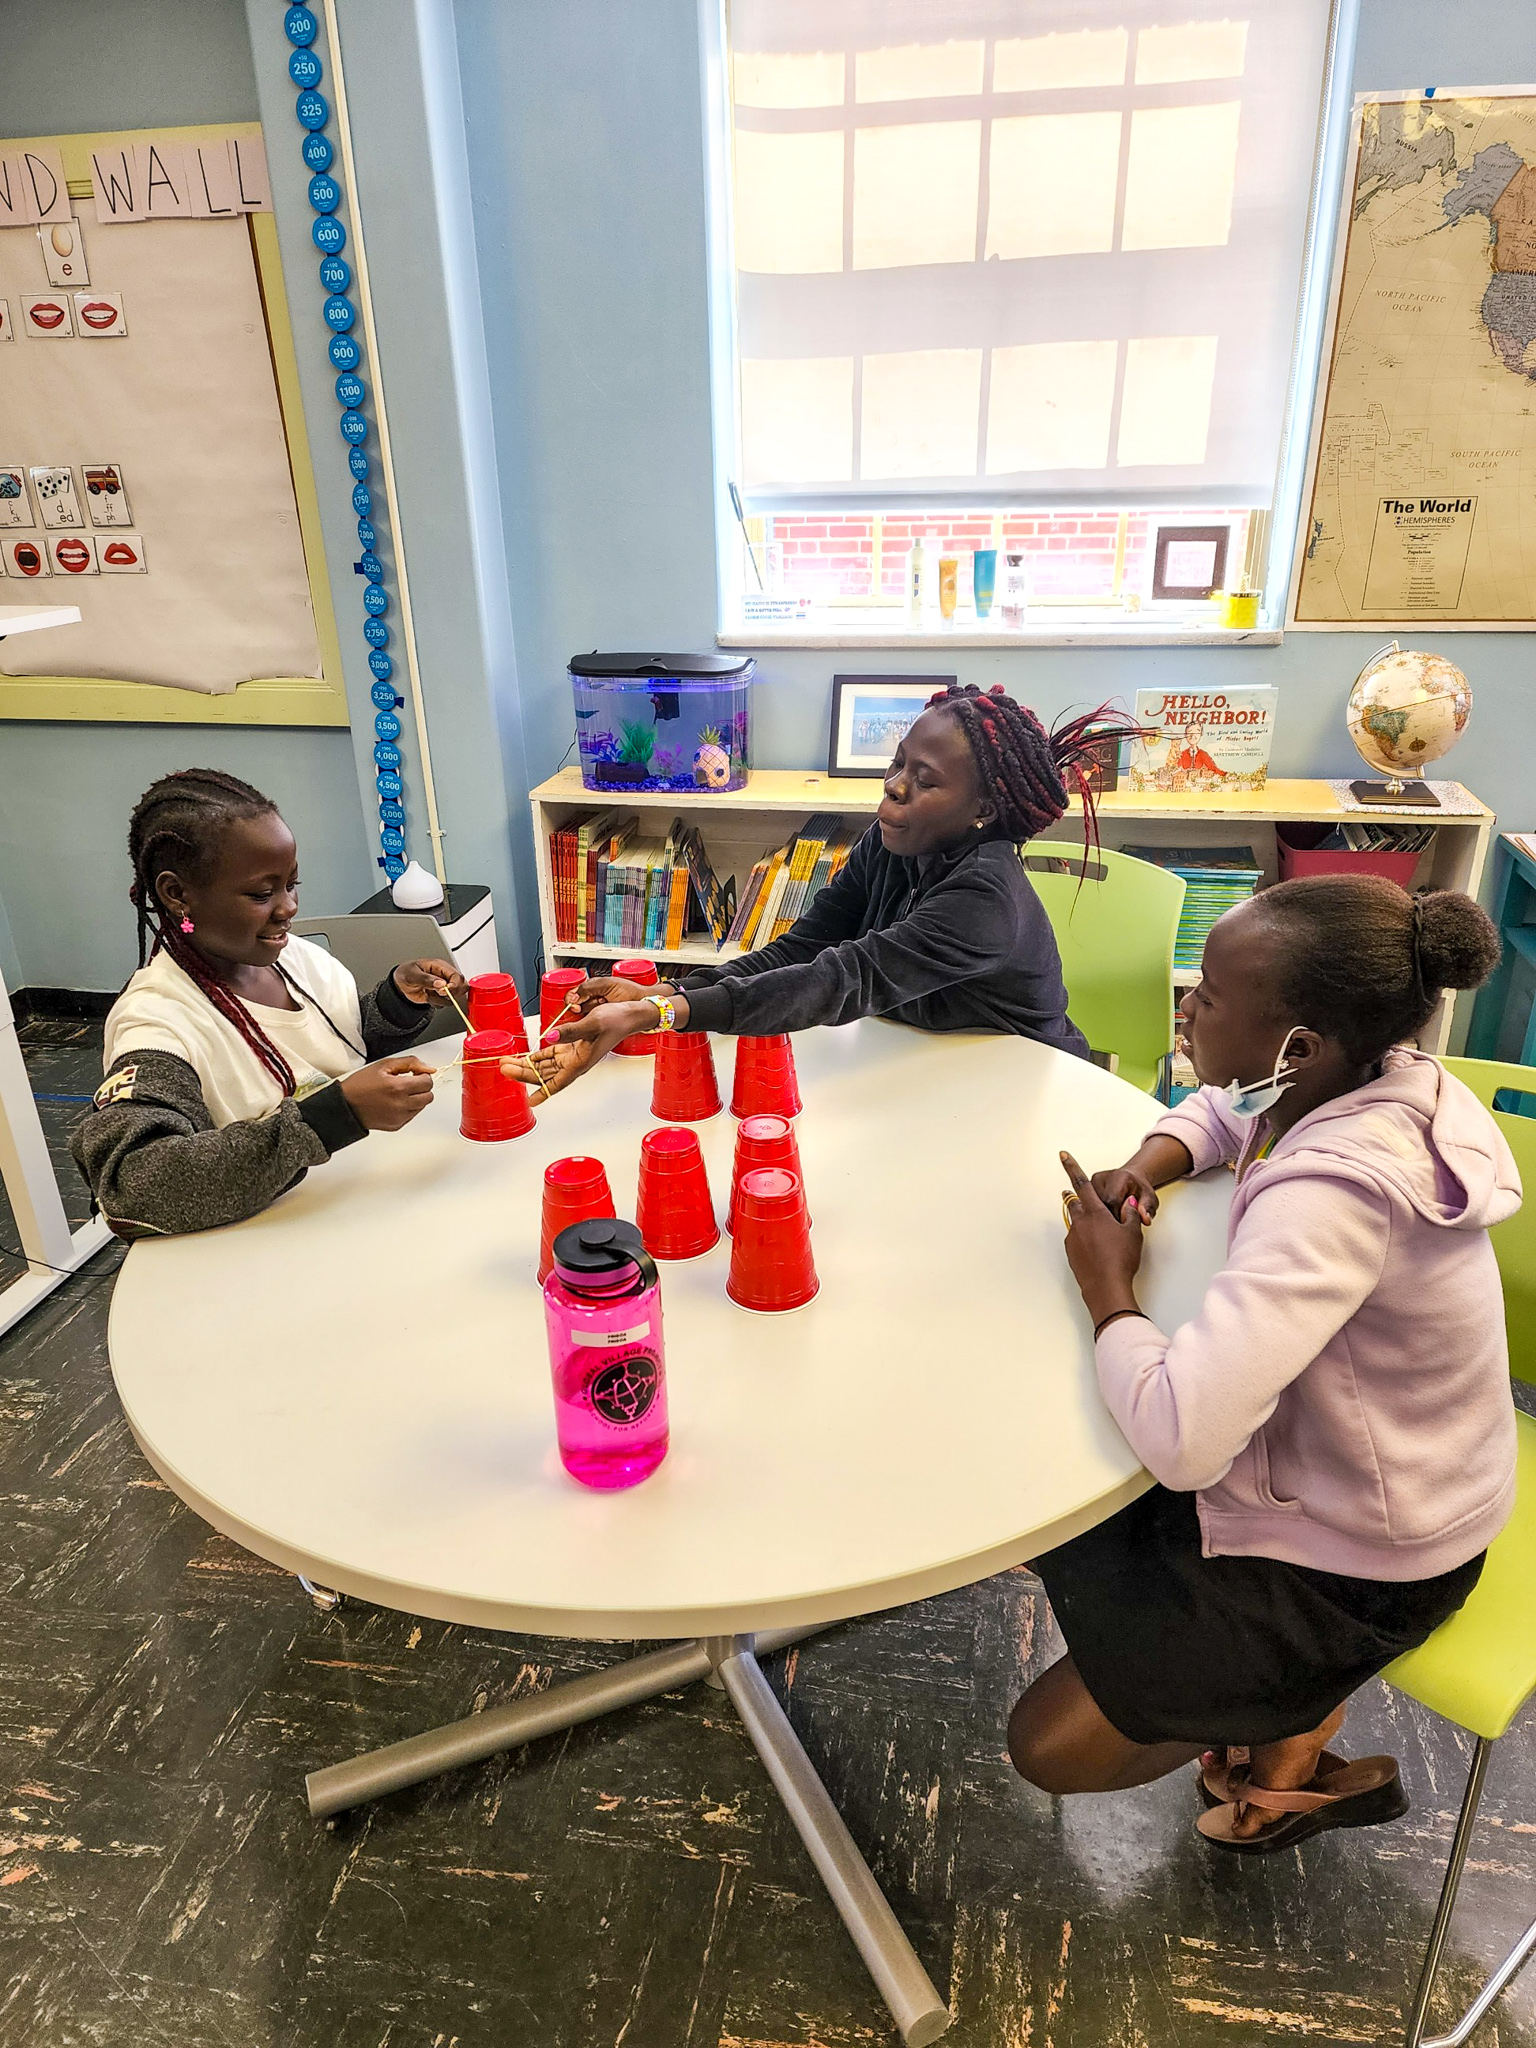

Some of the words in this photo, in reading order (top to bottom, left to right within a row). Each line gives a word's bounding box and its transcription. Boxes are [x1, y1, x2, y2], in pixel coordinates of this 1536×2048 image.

[290, 19, 310, 34] 200
[294, 62, 315, 74] 250
[301, 104, 322, 116] 325
[1395, 138, 1418, 154] RUSSIA
[308, 146, 327, 159] 400
[92, 139, 262, 216] WALL
[313, 187, 333, 200] 500
[318, 228, 339, 241] 600
[62, 264, 72, 276] e
[324, 269, 344, 281] 700
[1374, 289, 1406, 300] NORTH
[1408, 293, 1447, 304] PACIFIC
[1392, 303, 1424, 313] OCEAN
[329, 308, 348, 320] 800
[333, 347, 354, 358] 900
[340, 385, 360, 398] 1,100
[343, 423, 364, 434] 1,300
[1450, 451, 1481, 459] SOUTH
[1483, 449, 1522, 457] PACIFIC
[351, 460, 366, 470] 1,500
[1468, 461, 1499, 469] OCEAN
[354, 495, 368, 506] 1,750
[57, 500, 64, 513] d
[1383, 500, 1415, 514] The
[1420, 499, 1472, 513] World
[106, 513, 116, 524] ph
[1403, 516, 1456, 524] HEMISPHERES
[359, 530, 374, 540] 2,000
[363, 563, 380, 573] 2,250
[366, 595, 384, 605] 2,500
[366, 628, 385, 638] 2,750
[370, 660, 388, 670] 3,000
[374, 691, 394, 700] 3,250
[1145, 695, 1230, 716] HELLO,
[1164, 710, 1267, 726] NEIGHBOR!
[377, 722, 398, 732] 3,500
[376, 752, 398, 761] 4,000
[378, 781, 400, 791] 4,500
[382, 810, 402, 819] 5,000
[383, 838, 402, 847] 5,500
[386, 865, 404, 874] 6,000
[581, 1364, 603, 1395] GLOBAL
[601, 1347, 642, 1365] VILLAGE
